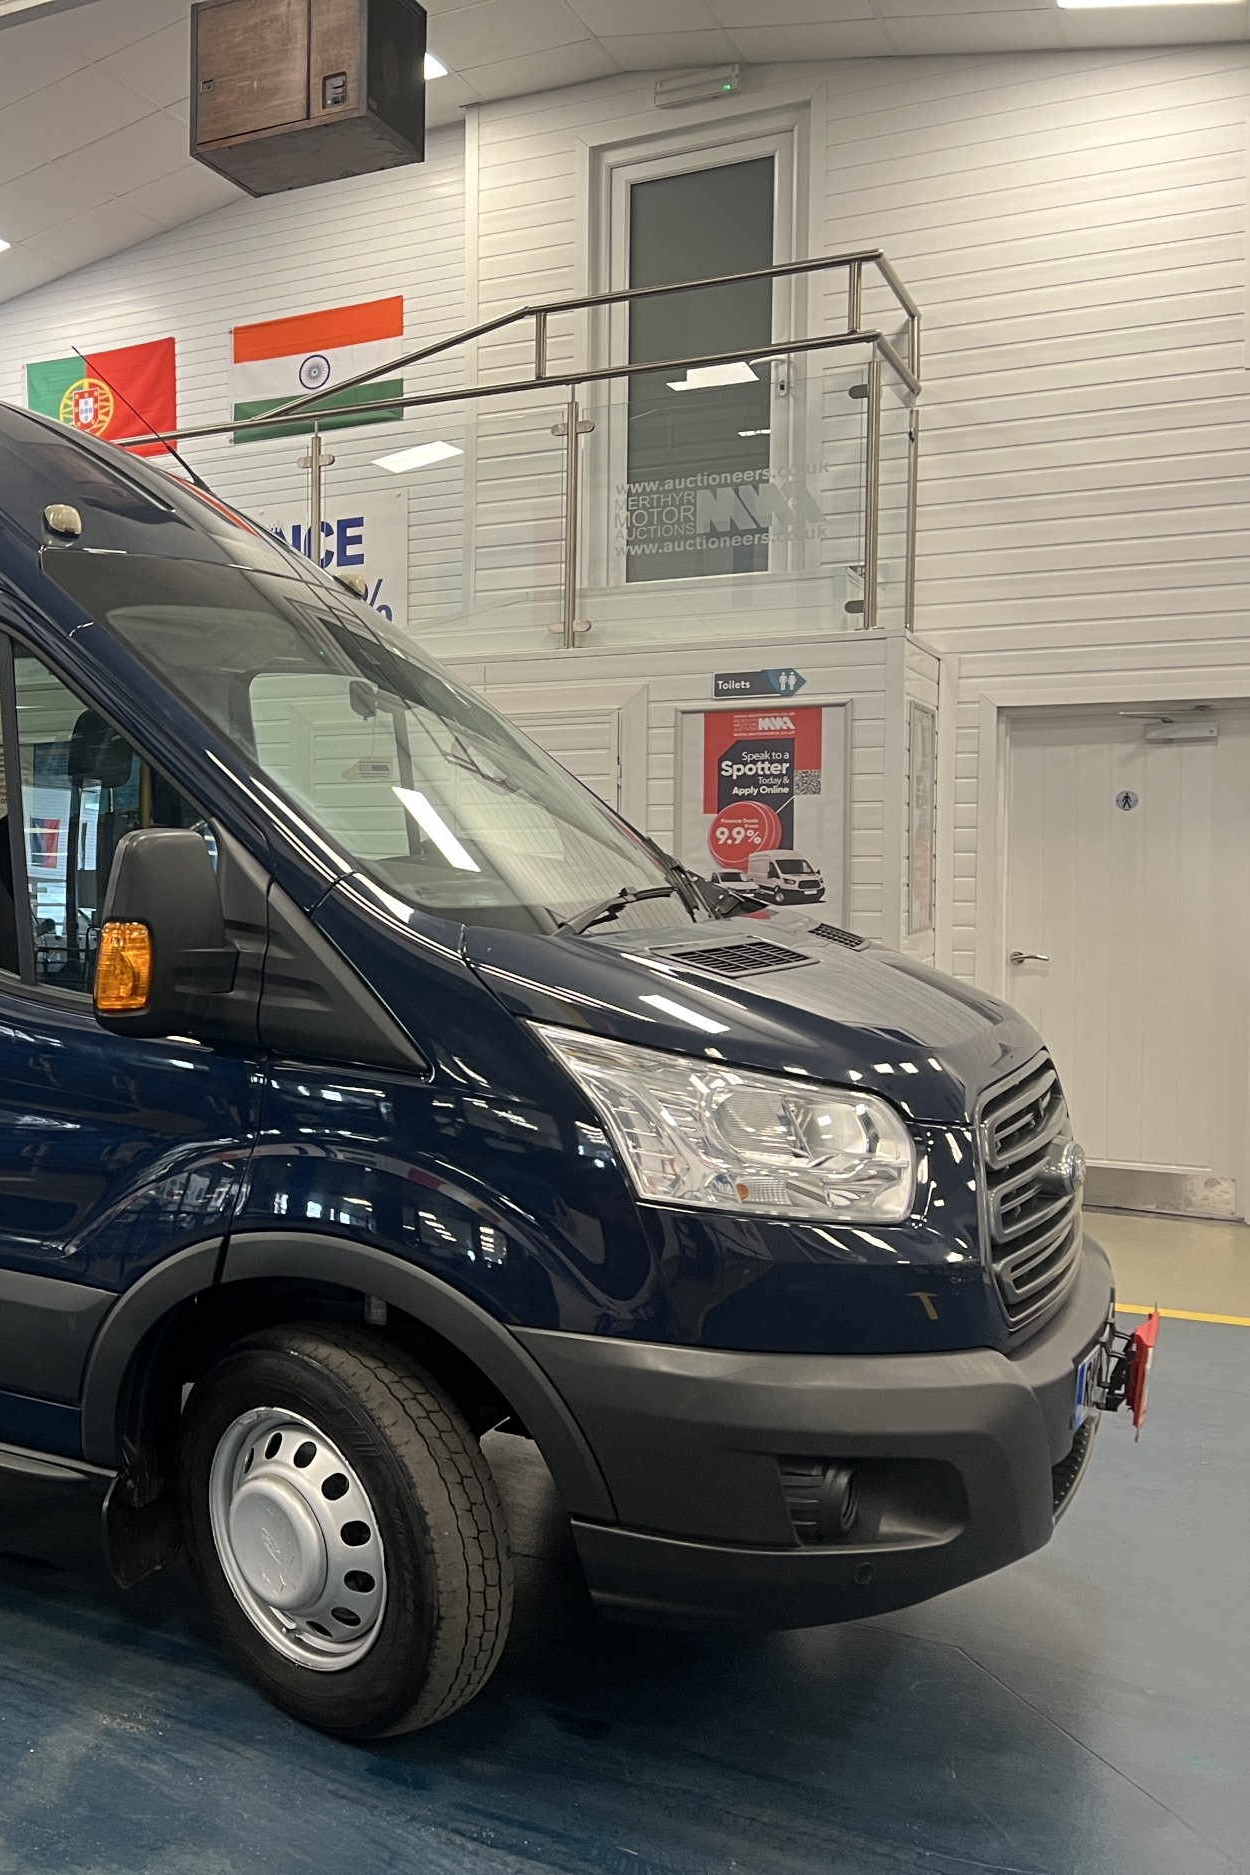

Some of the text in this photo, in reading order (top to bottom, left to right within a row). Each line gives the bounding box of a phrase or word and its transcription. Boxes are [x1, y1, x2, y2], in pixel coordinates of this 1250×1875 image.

[616, 460, 830, 495] www.auctioneers.couk
[614, 491, 695, 512] MERTHYR
[614, 505, 695, 529] MOTOR
[614, 522, 695, 542] AUCTIONS
[614, 525, 829, 557] www.auctioneers.couk
[717, 680, 751, 690] Toilets
[741, 751, 771, 762] Speak
[772, 751, 783, 760] to
[721, 760, 790, 779] Spotter
[757, 776, 790, 785] Today &
[732, 786, 790, 796] Apply Online
[715, 826, 762, 845] 9.9%
